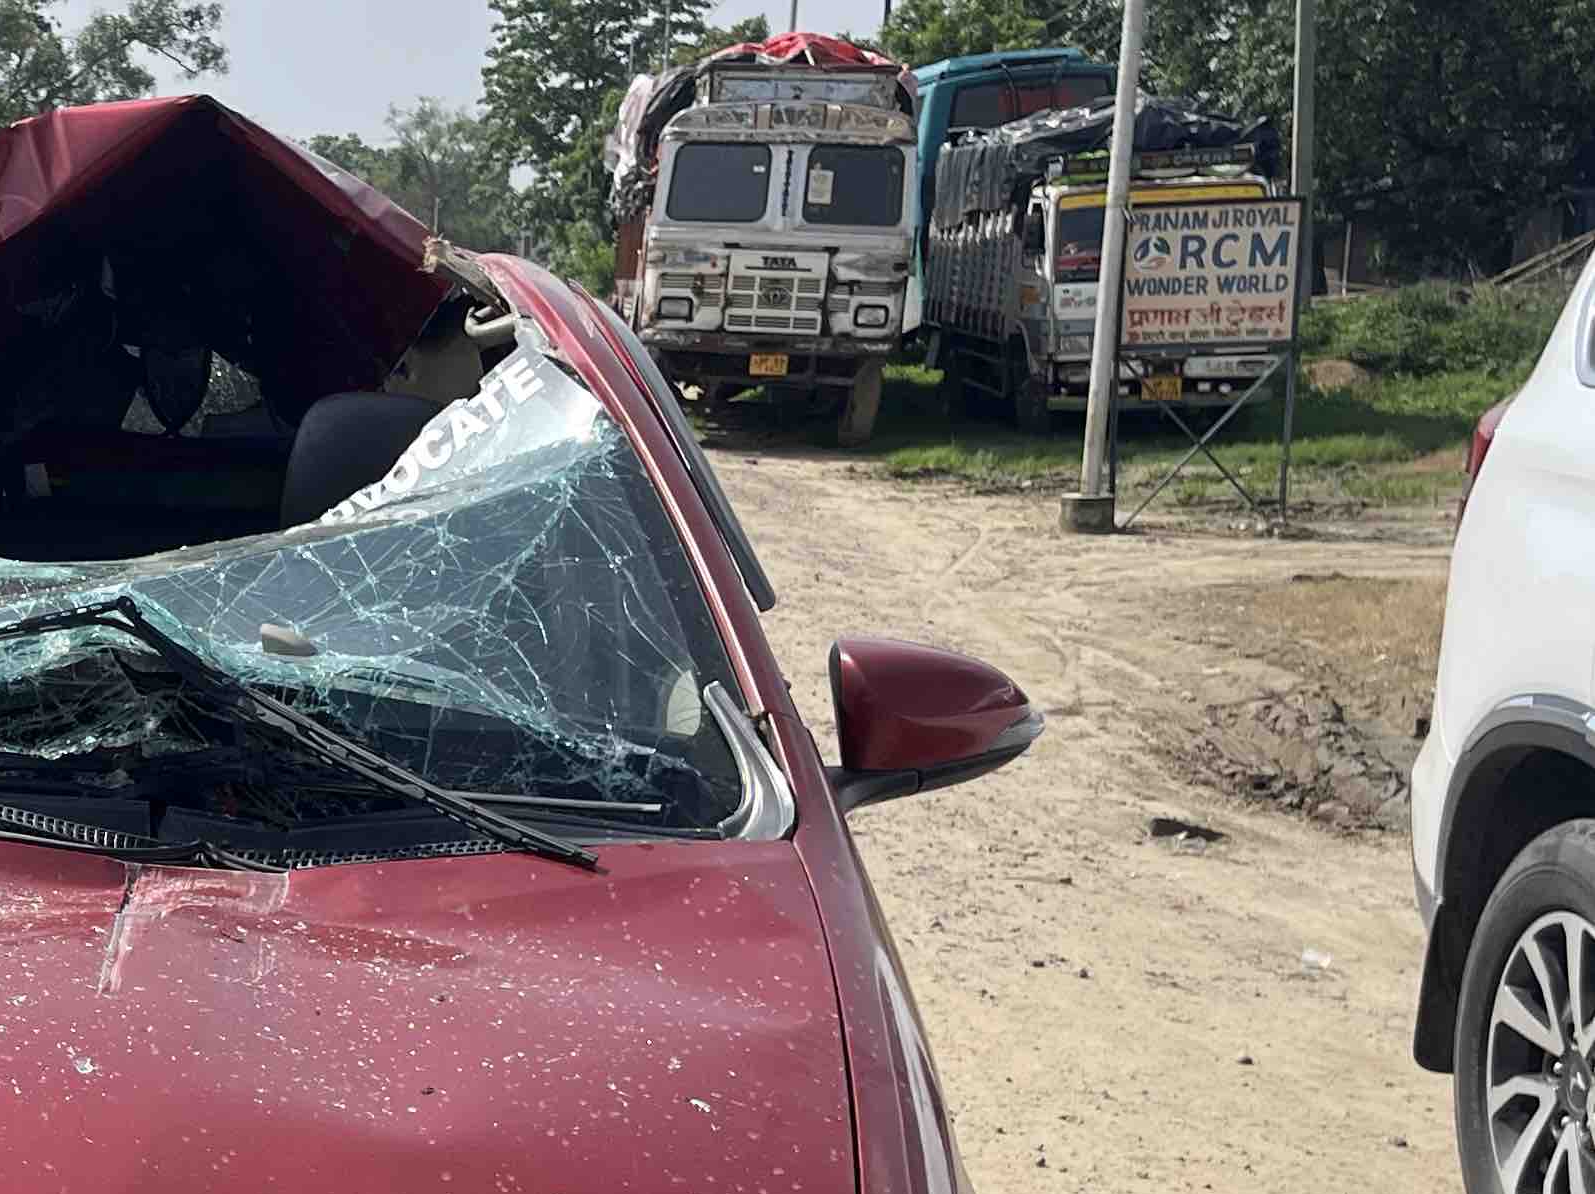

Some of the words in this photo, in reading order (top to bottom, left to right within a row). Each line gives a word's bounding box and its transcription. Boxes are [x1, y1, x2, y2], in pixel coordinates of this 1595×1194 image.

[1129, 209, 1208, 232] PRANAM
[1233, 204, 1294, 227] ROYAL
[761, 256, 797, 268] TATA
[1179, 232, 1290, 269] RCM
[1126, 275, 1208, 297] WONDER
[1217, 273, 1289, 295] WORLD
